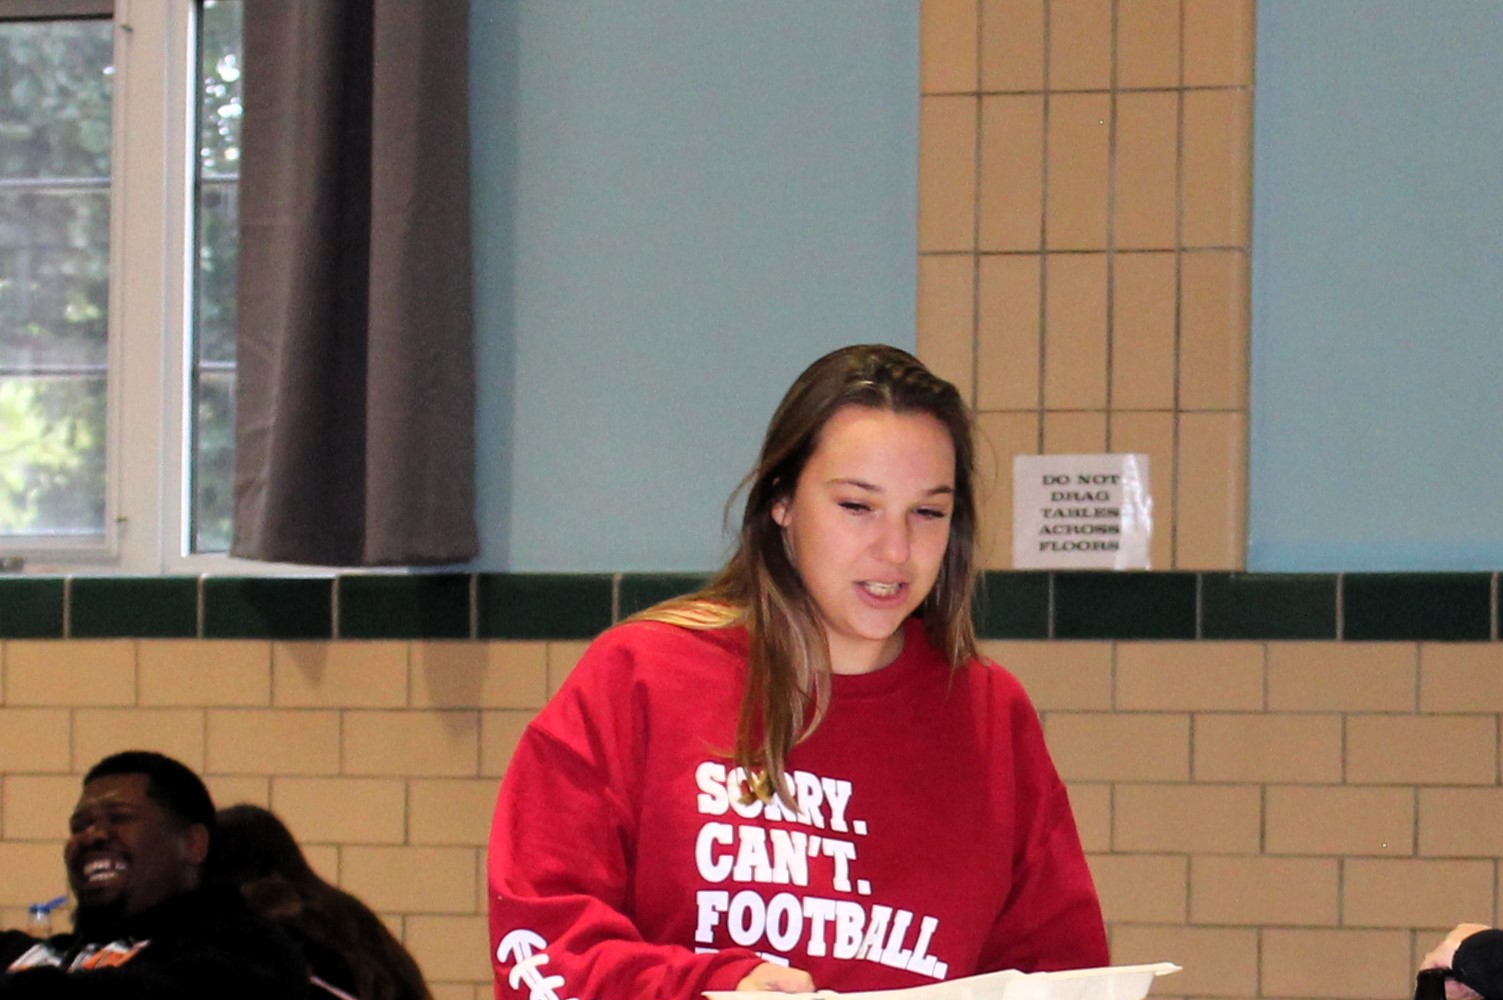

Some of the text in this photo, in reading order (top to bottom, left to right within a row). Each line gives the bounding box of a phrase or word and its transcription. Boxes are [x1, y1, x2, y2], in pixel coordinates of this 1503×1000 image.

[1041, 474, 1120, 486] DO NOT
[1051, 491, 1110, 502] DRAG
[1040, 507, 1120, 518] TABLES
[1039, 524, 1120, 535] ACROSS
[1039, 540, 1120, 551] FLOORS
[694, 822, 872, 896] CAN'T.
[694, 889, 949, 980] FOOTBALL.
